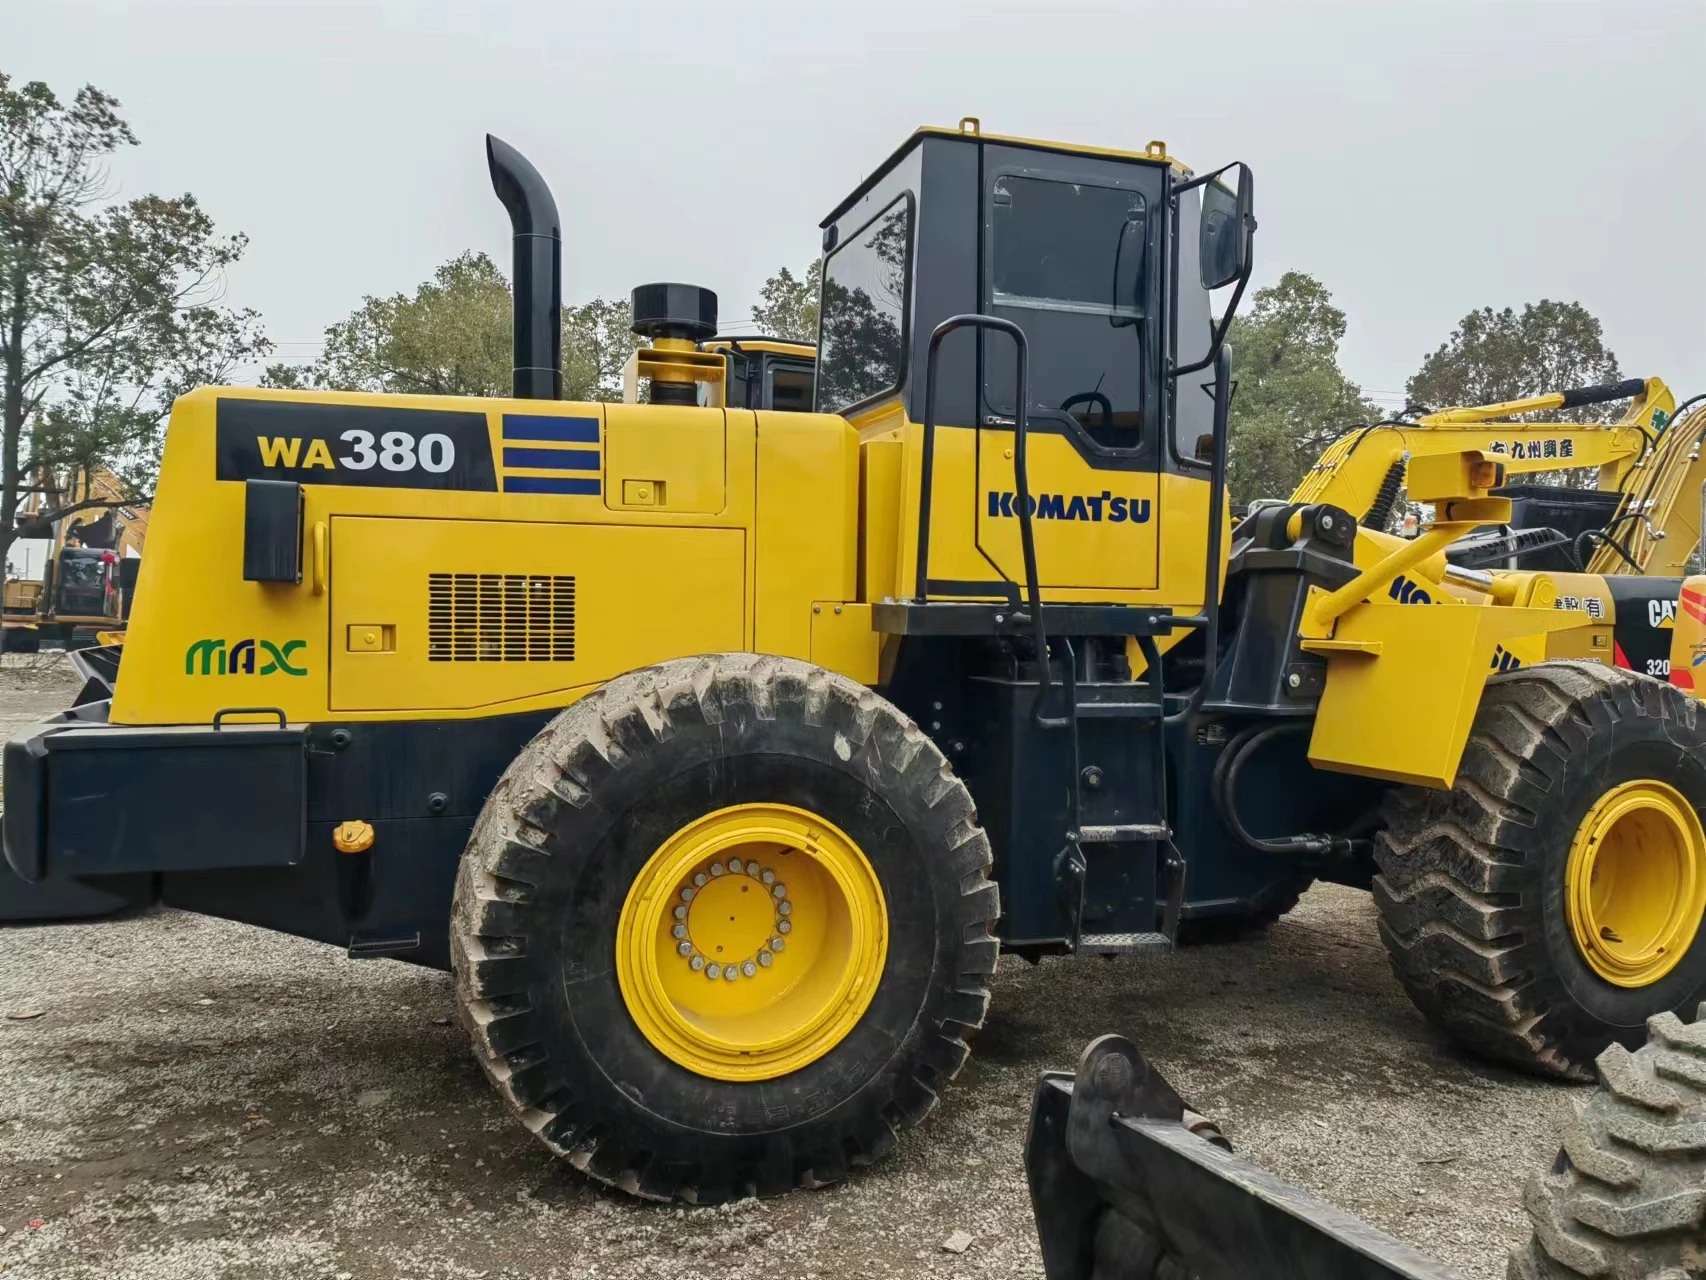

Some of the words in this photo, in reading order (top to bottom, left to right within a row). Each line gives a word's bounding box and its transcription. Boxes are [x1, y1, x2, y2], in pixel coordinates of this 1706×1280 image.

[988, 491, 1150, 524] KOMATSU
[1648, 599, 1678, 628] CA
[1646, 659, 1670, 676] 320
